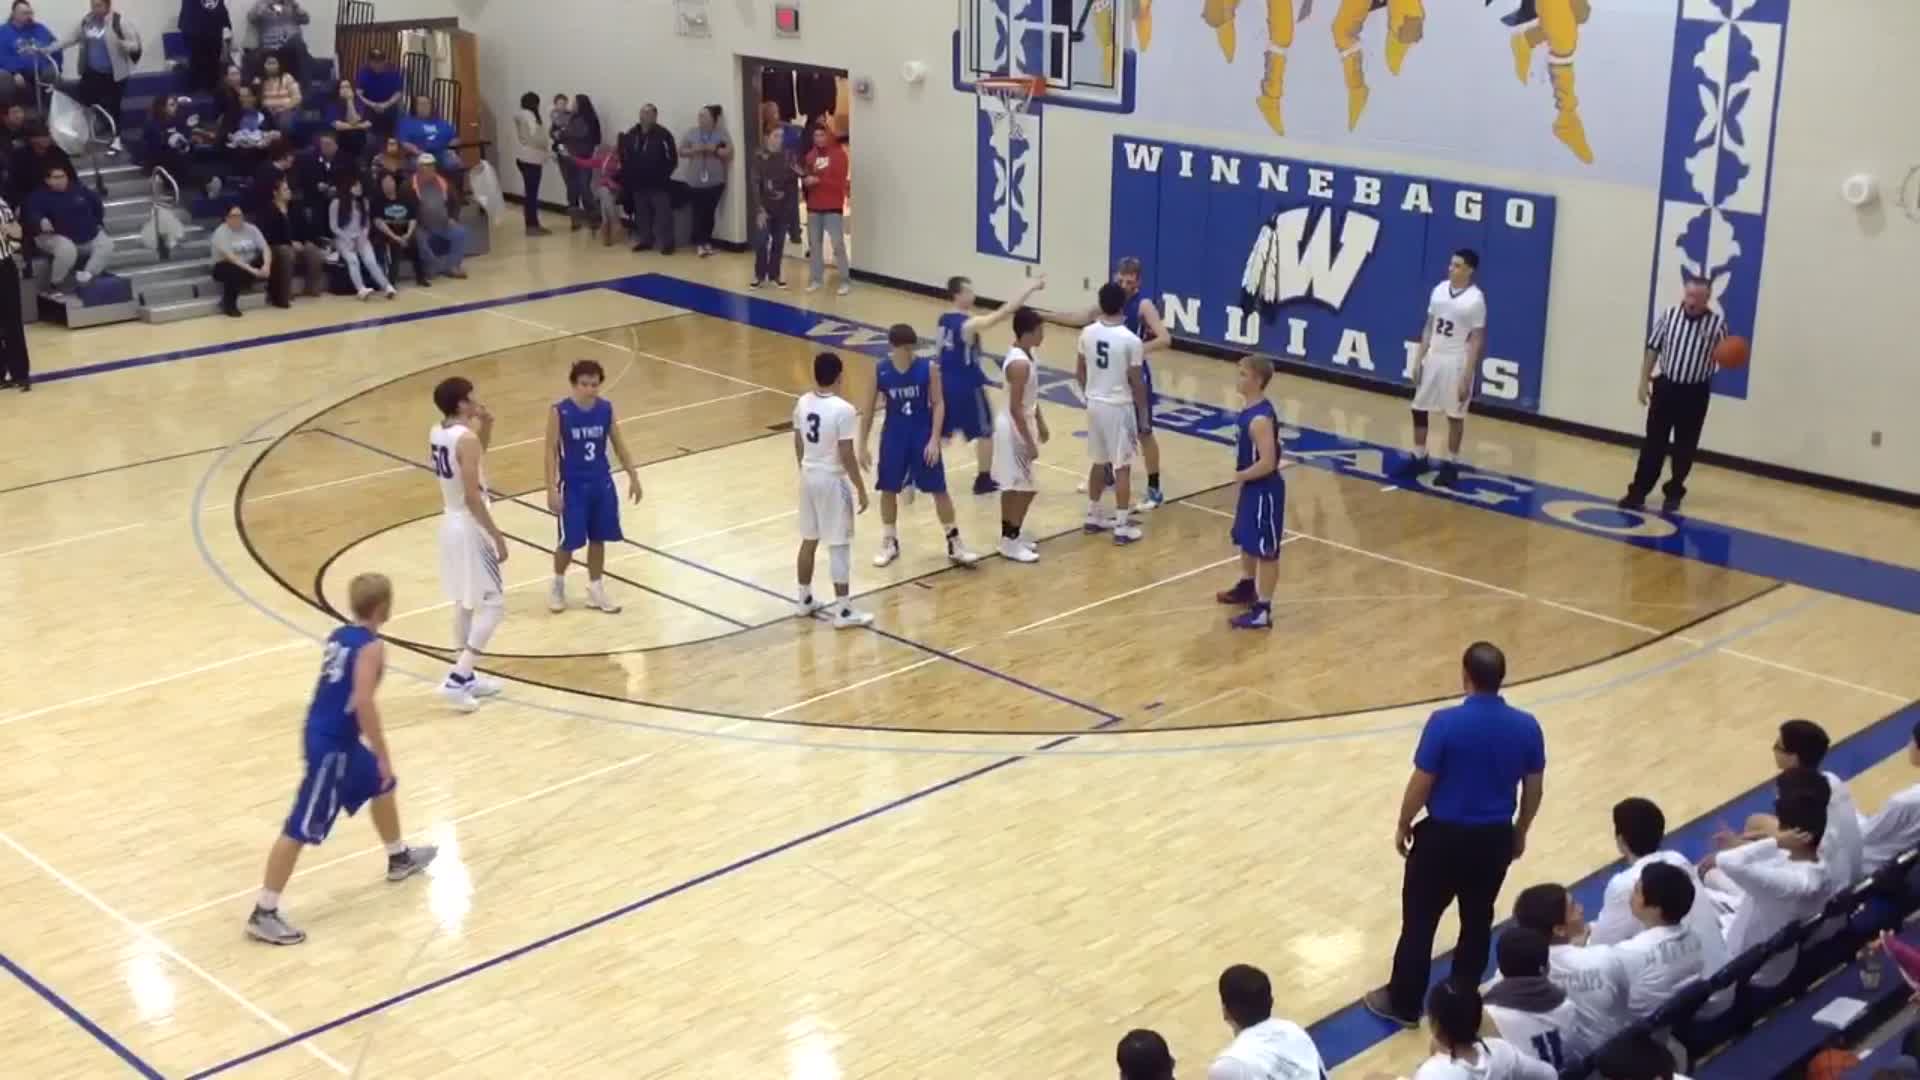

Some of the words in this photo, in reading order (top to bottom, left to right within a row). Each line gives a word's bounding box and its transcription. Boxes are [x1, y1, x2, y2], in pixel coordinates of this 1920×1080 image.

[1123, 141, 1536, 230] WINNEBAGO
[1435, 317, 1454, 337] 22
[1095, 341, 1109, 369] 5
[1162, 293, 1520, 400] NDIAS
[900, 401, 913, 416] 4
[806, 413, 821, 444] 3
[583, 442, 597, 462] 3
